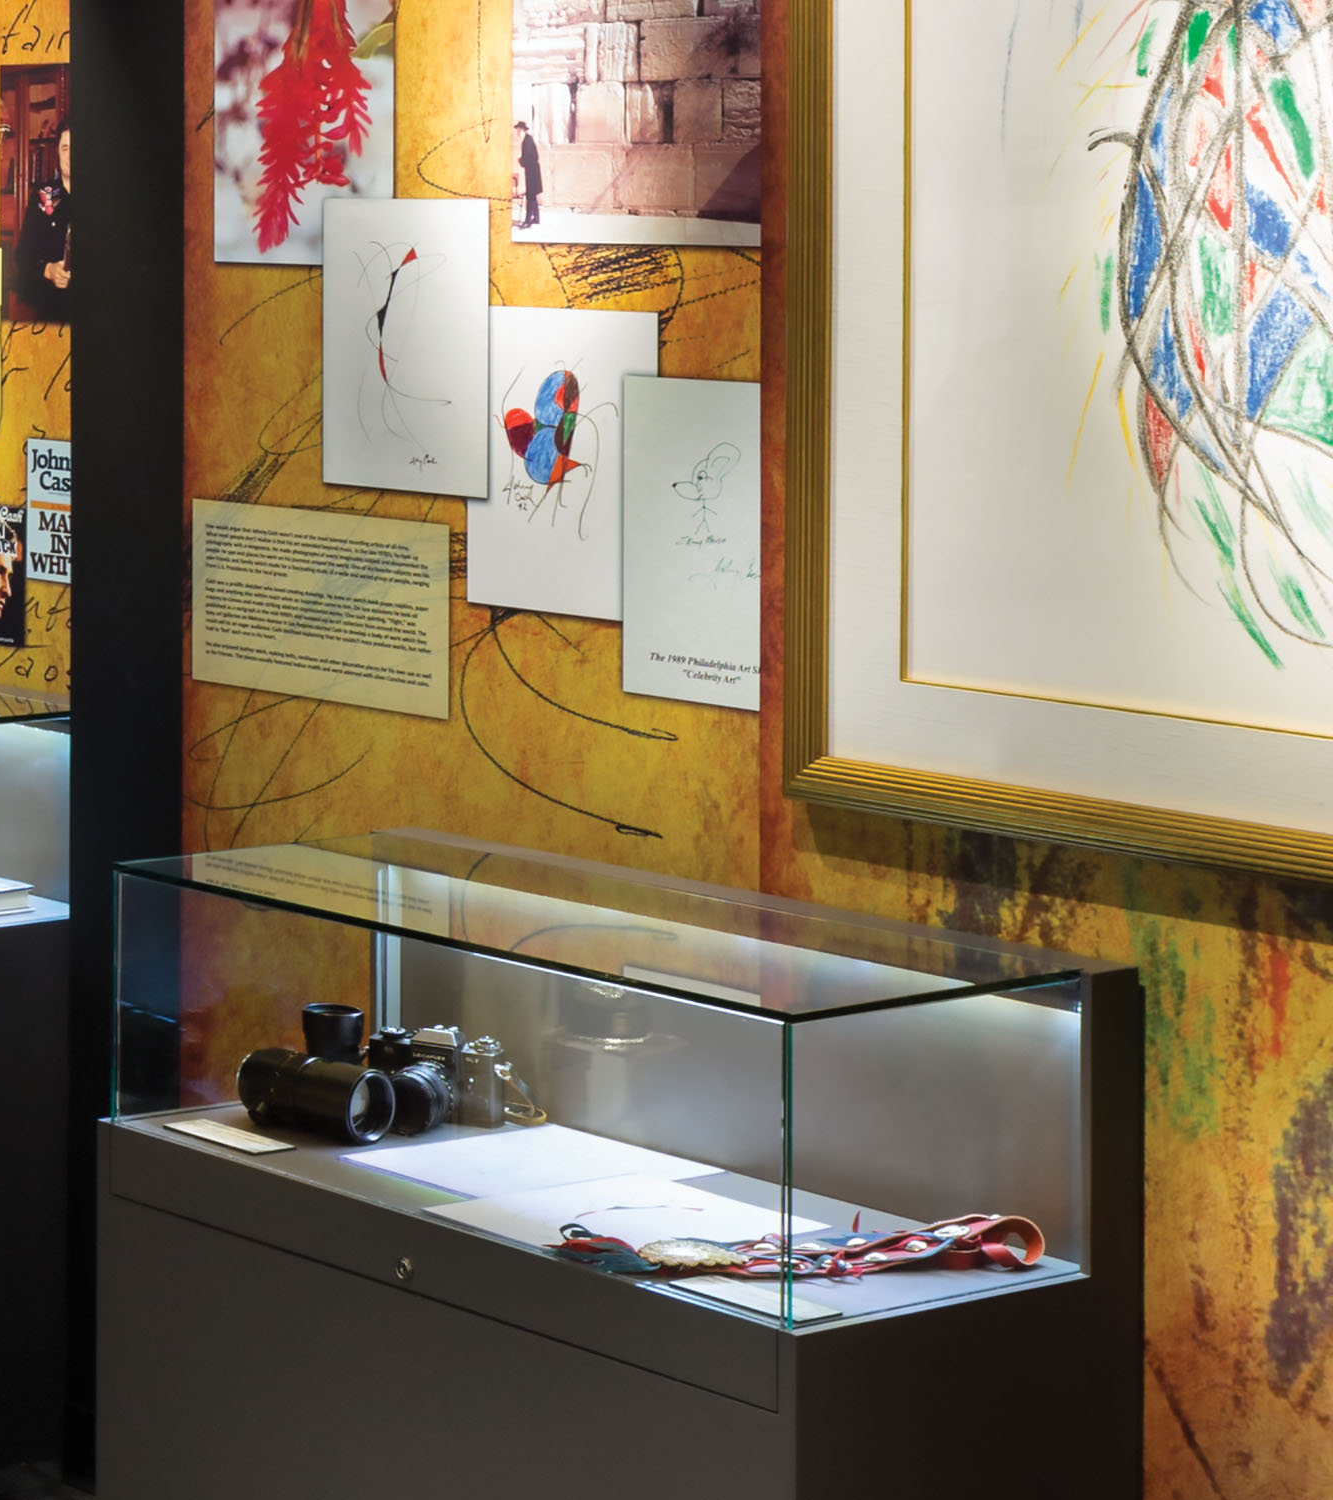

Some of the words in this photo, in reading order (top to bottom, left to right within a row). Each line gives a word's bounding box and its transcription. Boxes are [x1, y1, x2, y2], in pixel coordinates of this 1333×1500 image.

[37, 510, 72, 534] MA
[30, 551, 72, 577] WHI
[649, 652, 666, 664] The
[666, 654, 688, 667] 1989
[687, 656, 737, 676] Philadelphia
[737, 662, 753, 674] Art
